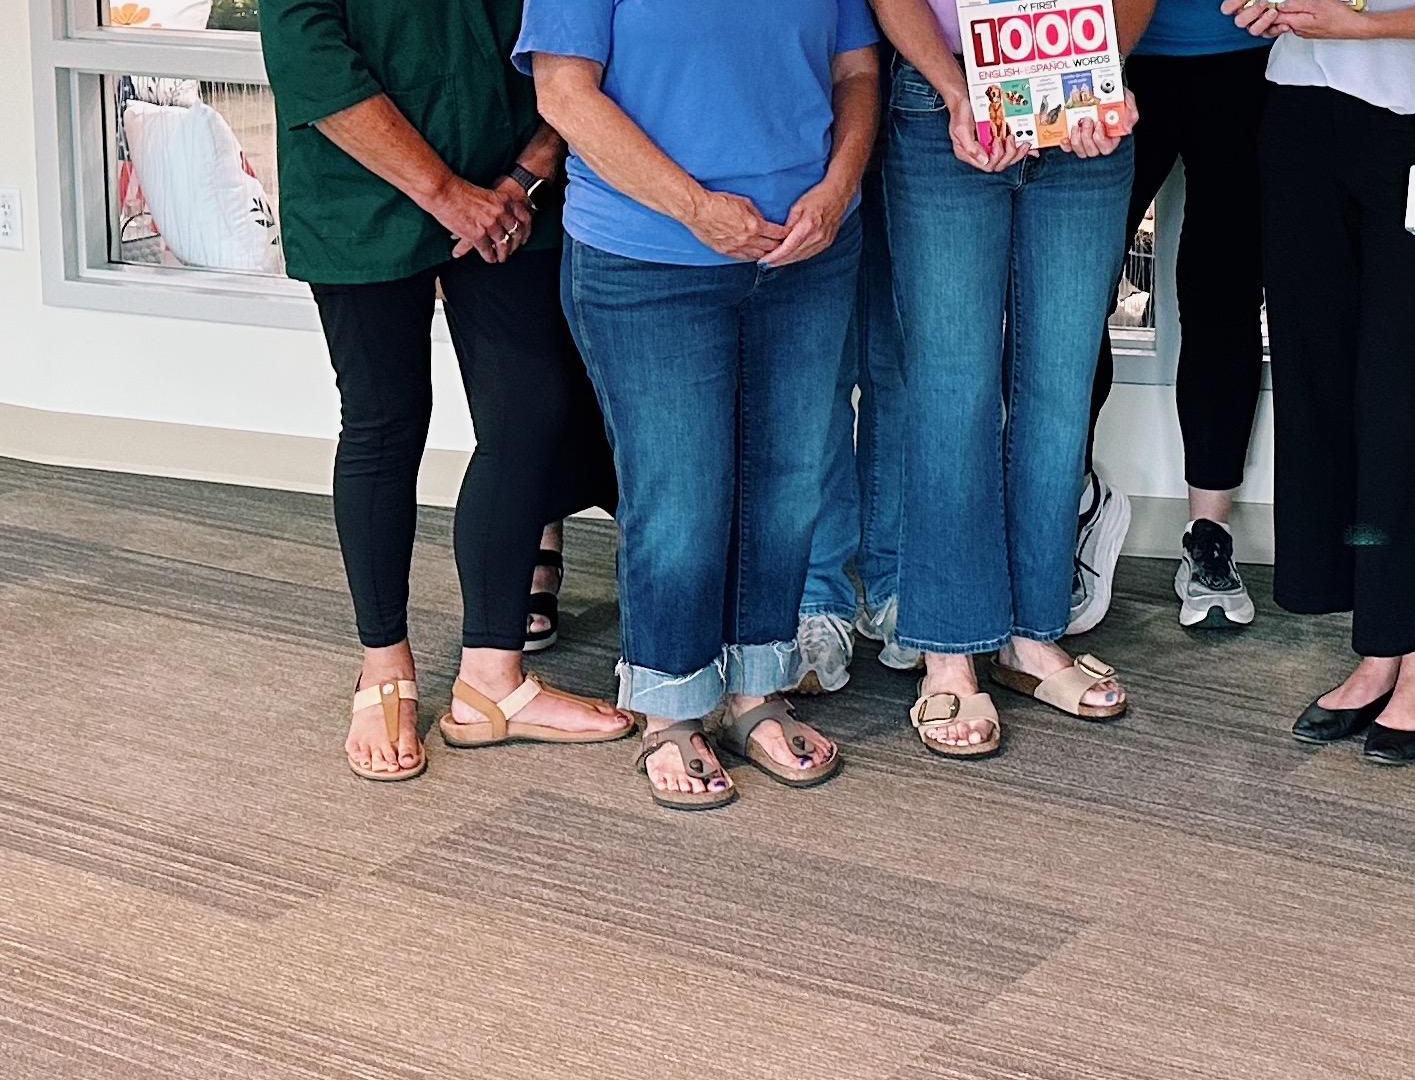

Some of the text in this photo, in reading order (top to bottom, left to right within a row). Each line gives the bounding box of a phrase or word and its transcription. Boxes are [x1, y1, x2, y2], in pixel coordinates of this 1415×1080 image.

[1030, 0, 1058, 11] FIRST
[972, 8, 1107, 65] 1000
[1072, 54, 1111, 68] WORDS
